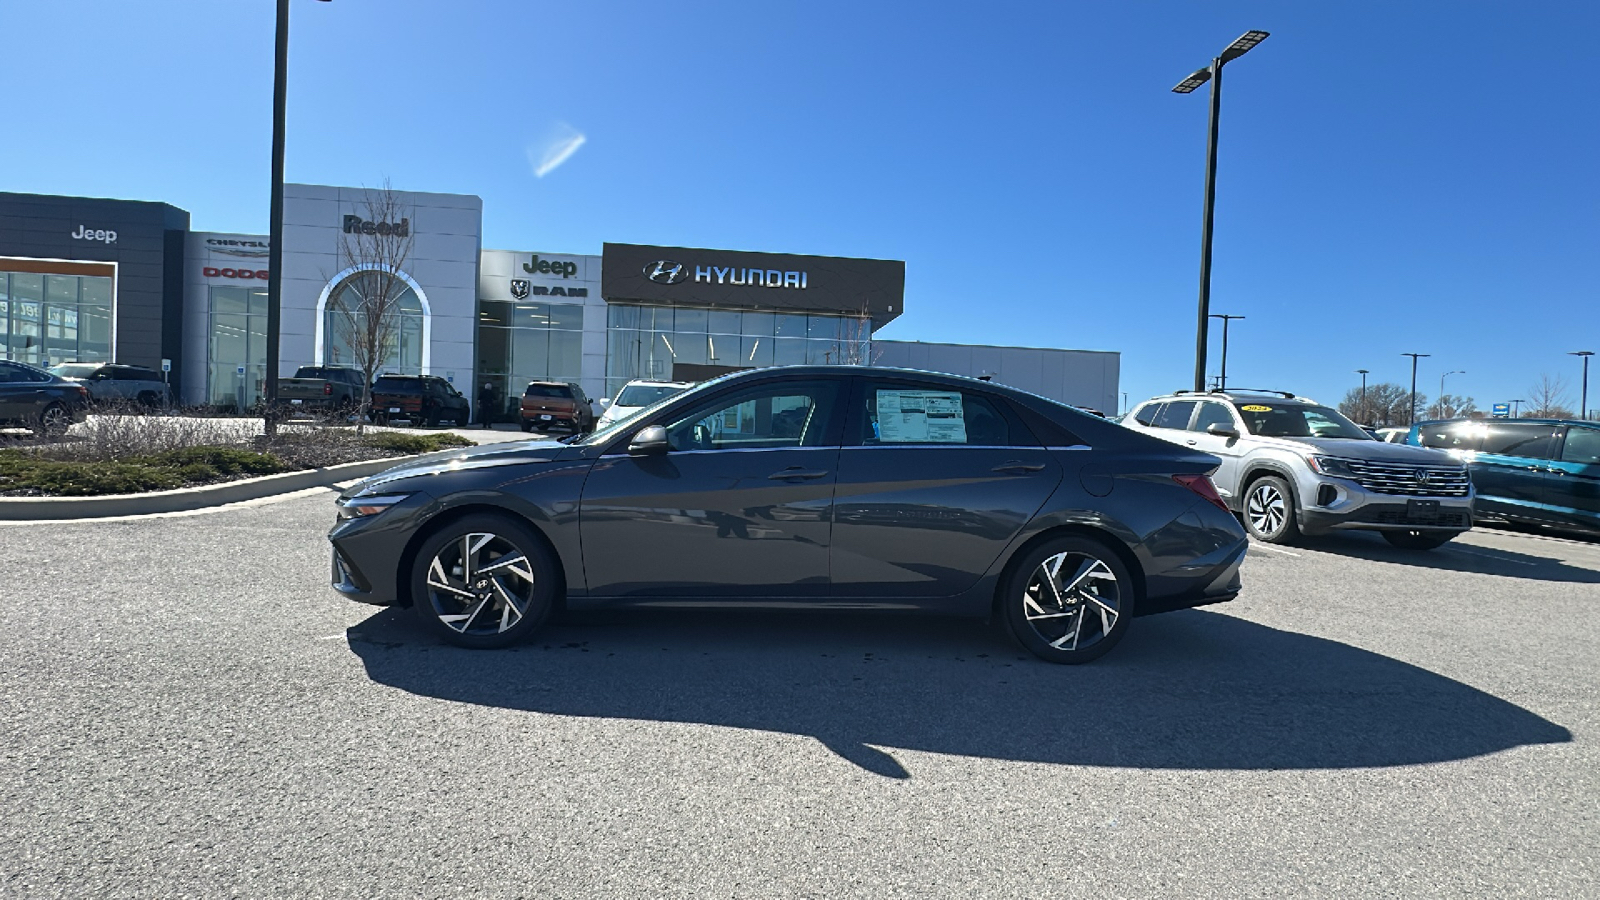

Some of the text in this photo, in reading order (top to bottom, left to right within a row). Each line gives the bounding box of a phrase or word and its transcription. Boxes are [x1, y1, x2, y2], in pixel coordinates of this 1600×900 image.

[71, 224, 117, 244] Jeep
[206, 238, 270, 248] CHRYSL
[202, 267, 270, 280] DODG
[522, 254, 577, 278] Jeep
[694, 265, 808, 289] HYUNDAI
[532, 285, 588, 297] RAM
